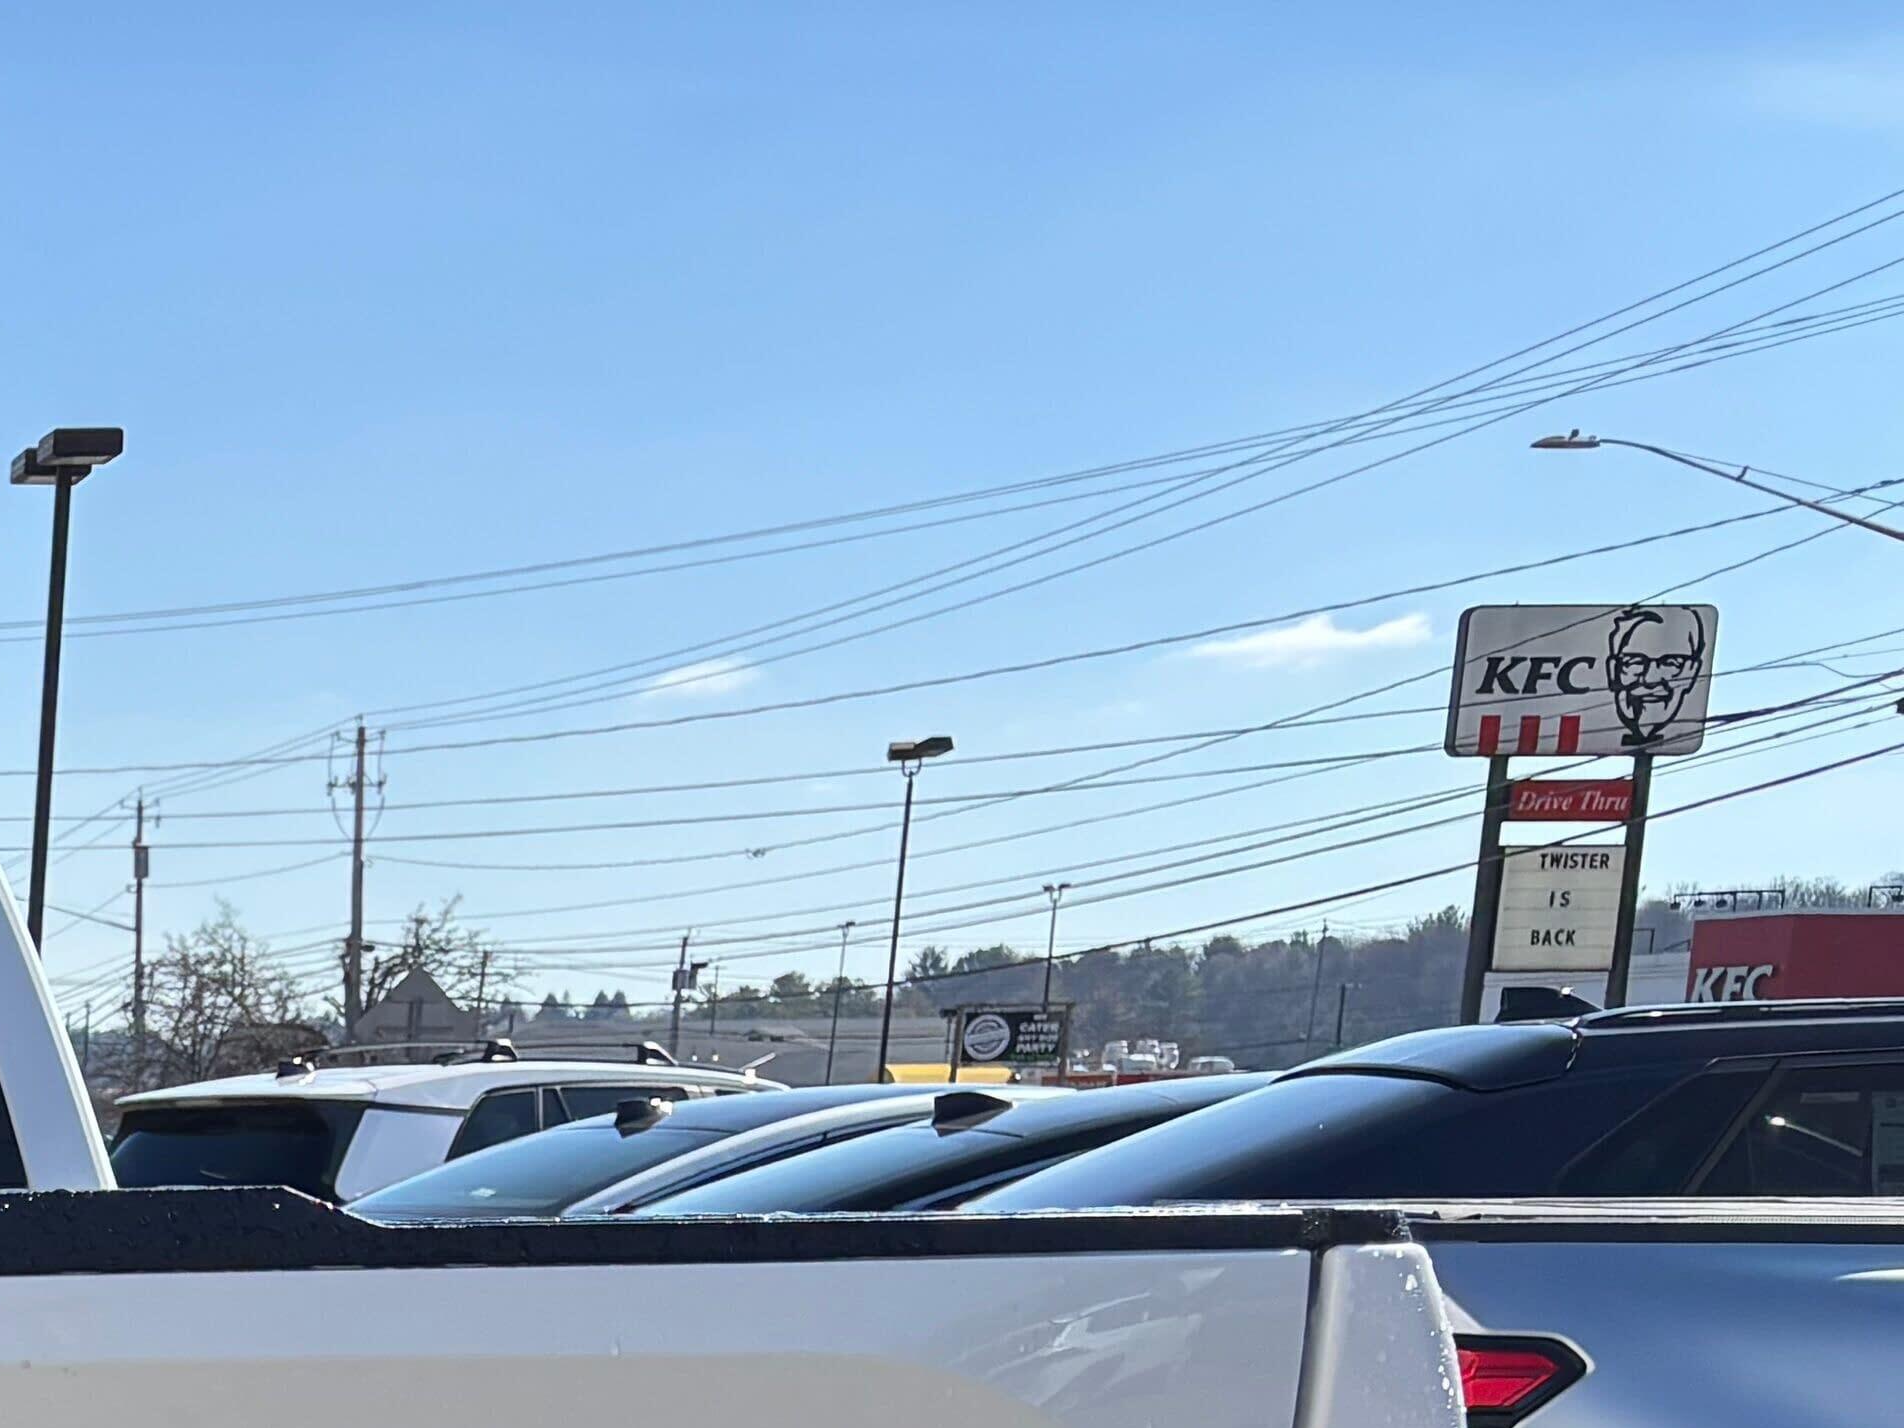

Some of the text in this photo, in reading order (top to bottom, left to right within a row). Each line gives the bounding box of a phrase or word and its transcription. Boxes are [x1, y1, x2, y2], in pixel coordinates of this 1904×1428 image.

[1475, 655, 1596, 694] KFC
[1516, 790, 1629, 812] Drive Thru
[1539, 852, 1610, 870] TWISTER
[1549, 891, 1570, 907] IS
[1530, 929, 1576, 946] BACK
[1691, 966, 1773, 1002] KFC
